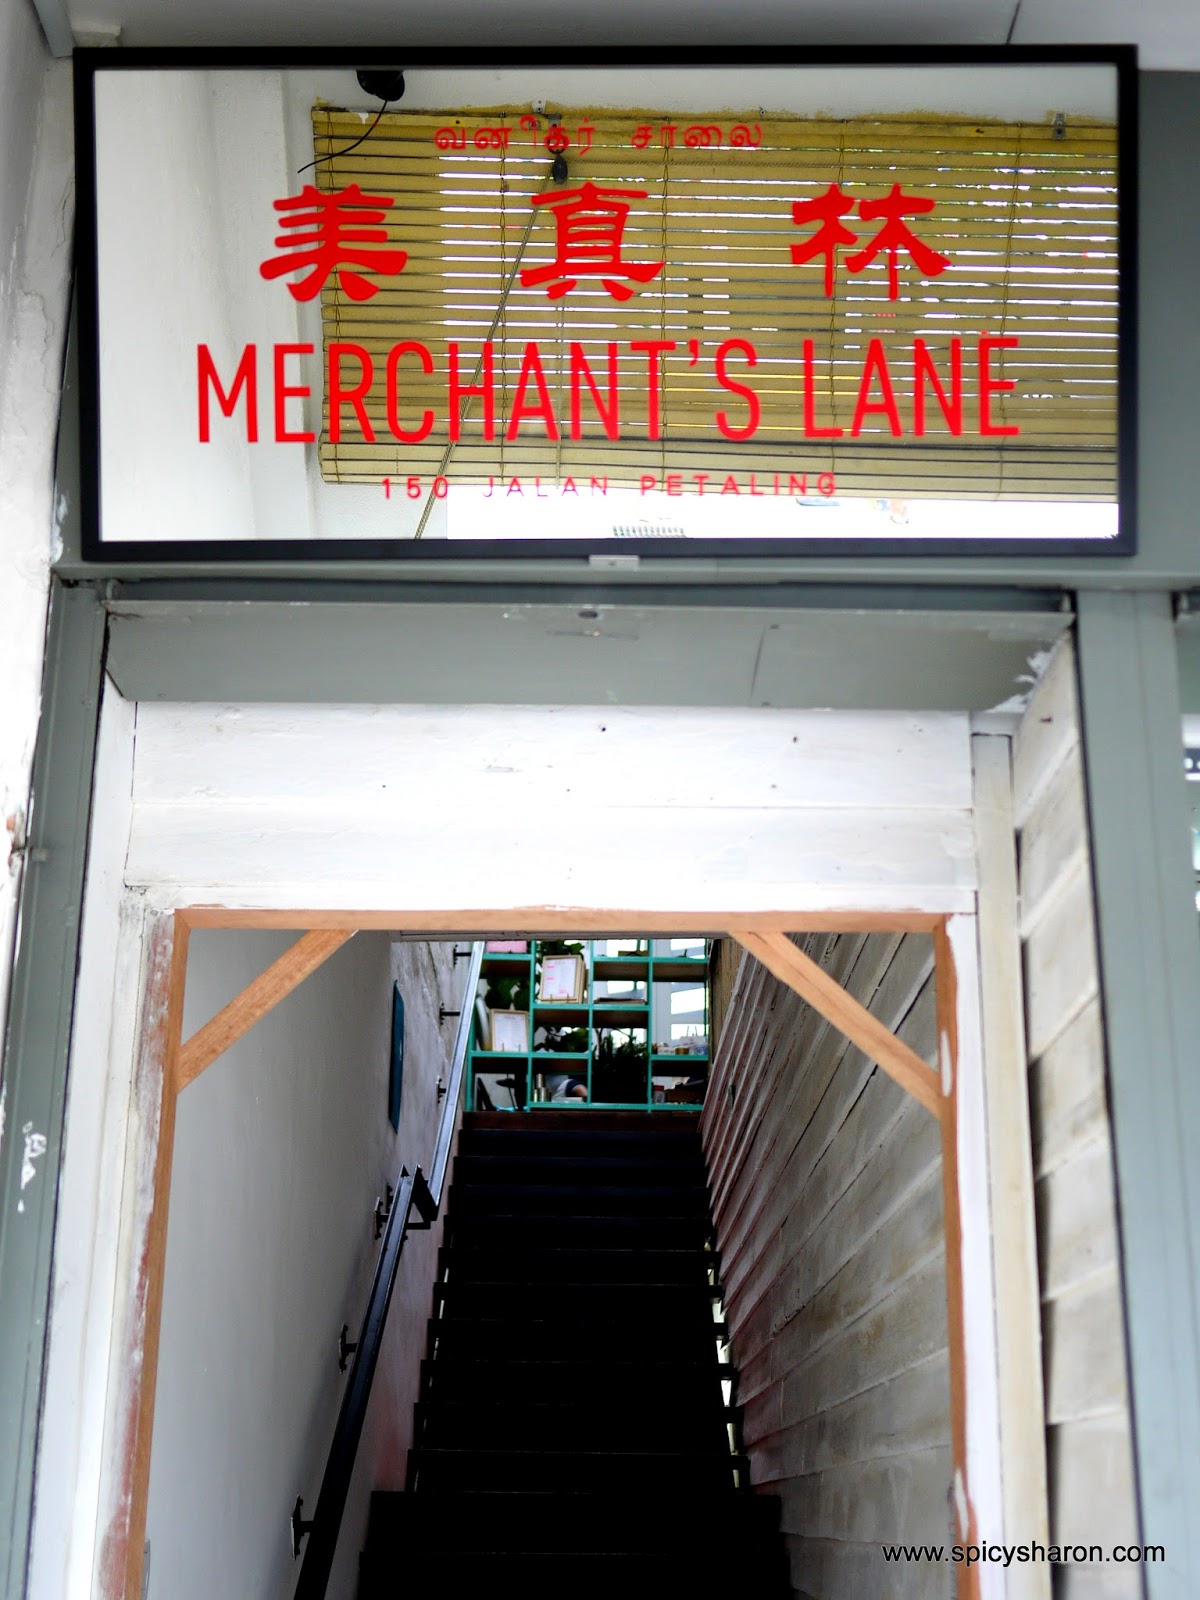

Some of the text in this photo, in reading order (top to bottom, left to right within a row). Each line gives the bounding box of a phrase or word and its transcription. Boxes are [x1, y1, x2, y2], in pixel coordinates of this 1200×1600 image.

[260, 181, 952, 303] 美真林
[197, 332, 1020, 444] MERCHANT'S LANE
[381, 471, 837, 500] 150 JALAN PETALING
